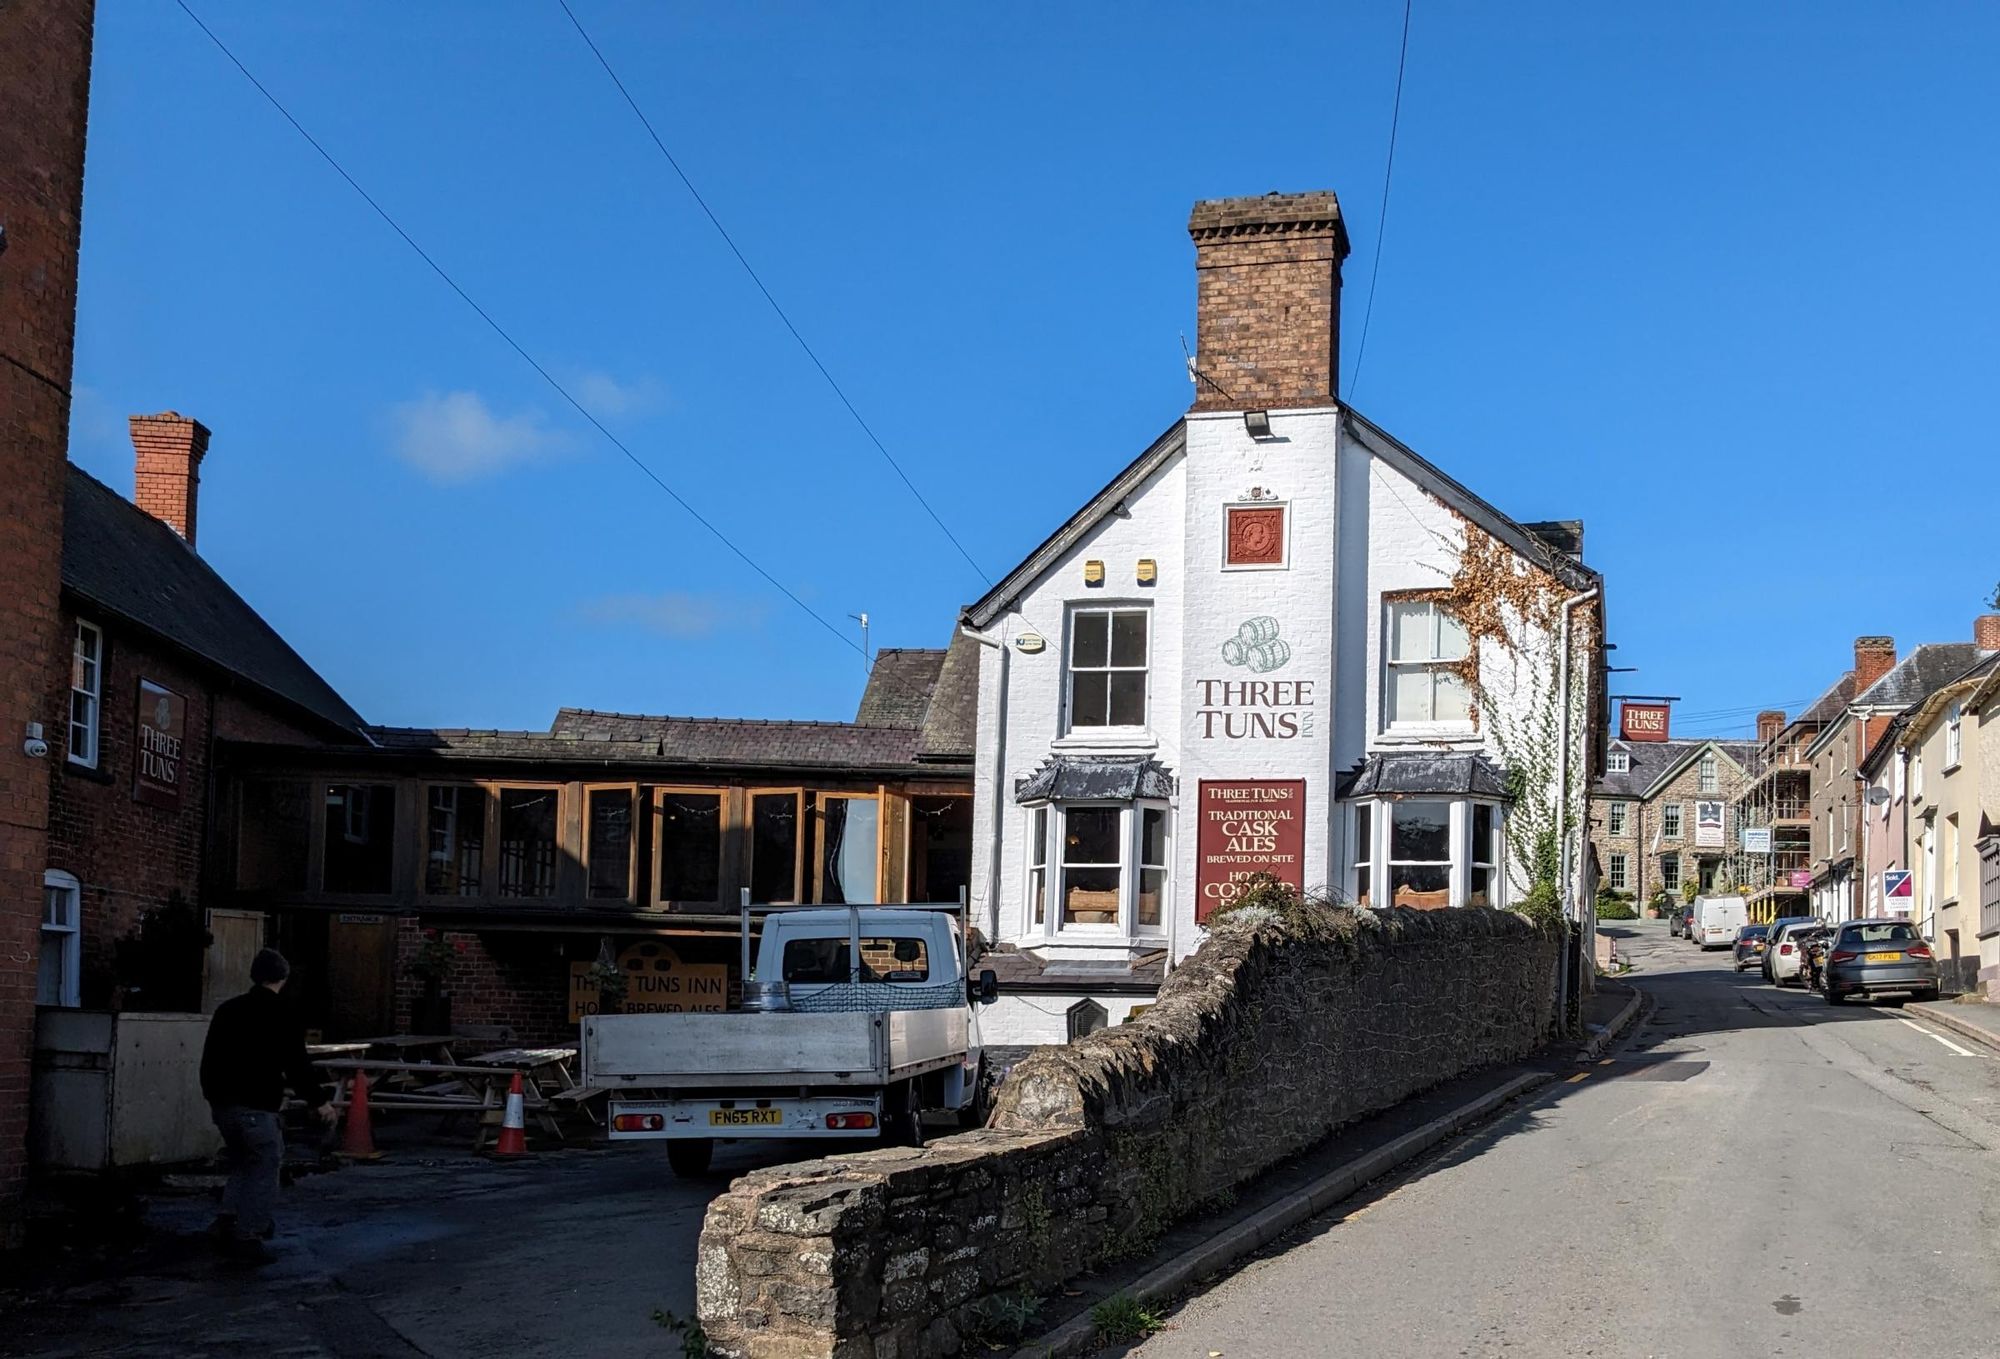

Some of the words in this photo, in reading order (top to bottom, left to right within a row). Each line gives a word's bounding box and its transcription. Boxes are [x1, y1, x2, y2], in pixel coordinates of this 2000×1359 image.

[1196, 680, 1314, 707] THREE
[1626, 709, 1664, 720] THREE
[1196, 710, 1298, 739] TUNS
[1302, 711, 1314, 738] INN
[1626, 718, 1659, 730] TUNS
[142, 724, 181, 760] THREE
[141, 749, 175, 783] TUNS
[1208, 788, 1250, 799] THREE
[1251, 788, 1288, 799] TUNS
[1208, 810, 1293, 820] TRADITIONAL
[1222, 821, 1279, 836] CASK
[1225, 837, 1276, 852] ALES
[1207, 855, 1250, 863] BREWED
[1252, 855, 1269, 863] ON
[1271, 855, 1294, 863] SITE
[1229, 872, 1271, 882] HO
[635, 976, 680, 992] TUNS
[688, 977, 721, 993] INN
[715, 1111, 748, 1123] FN65
[752, 1110, 777, 1122] RXT
